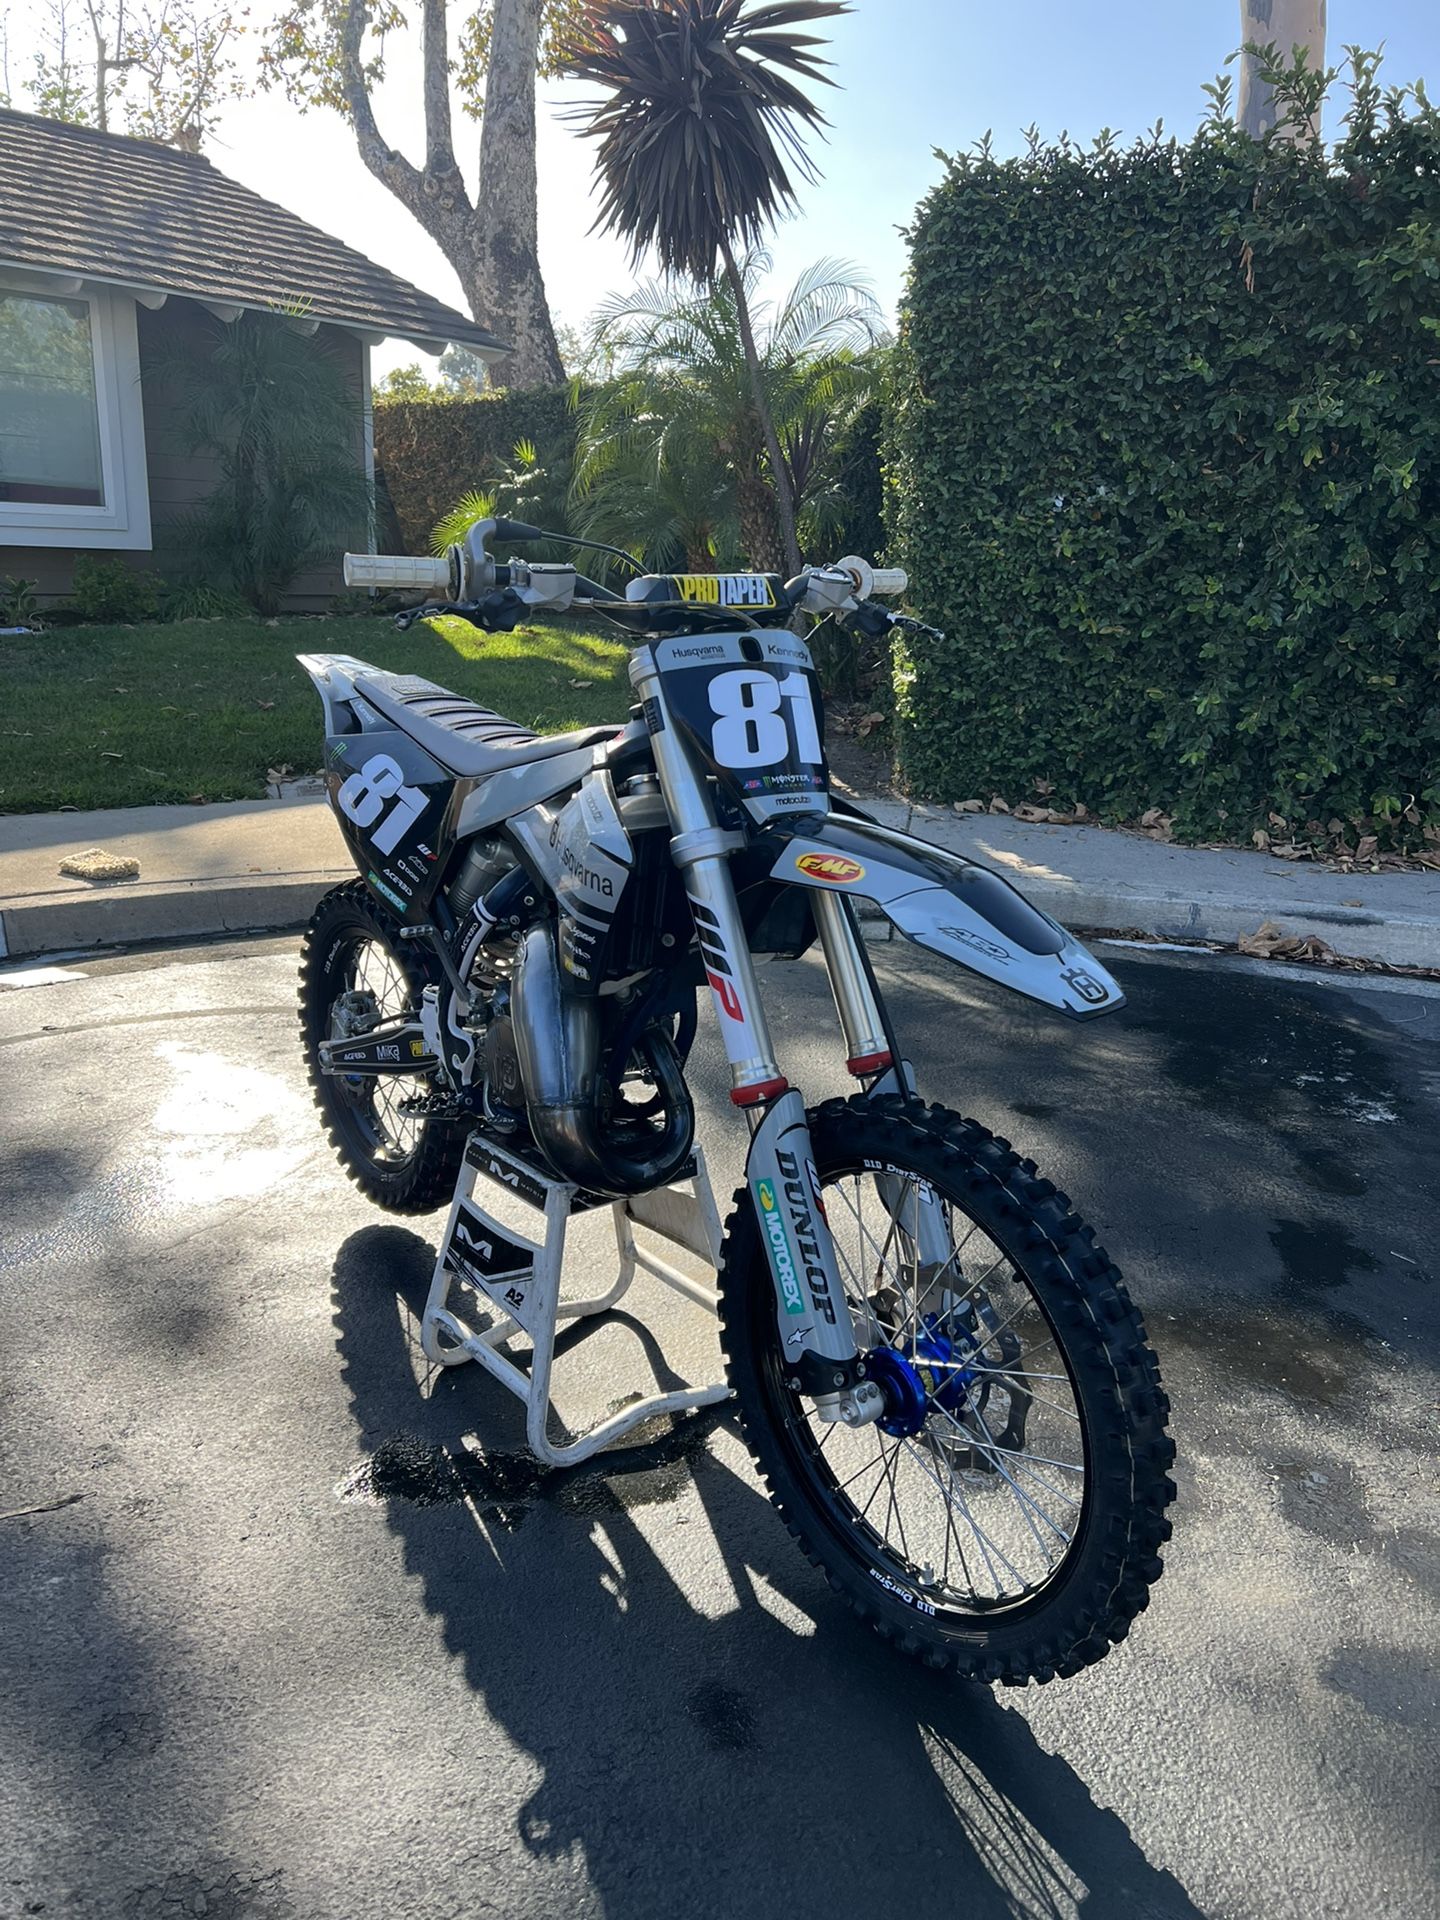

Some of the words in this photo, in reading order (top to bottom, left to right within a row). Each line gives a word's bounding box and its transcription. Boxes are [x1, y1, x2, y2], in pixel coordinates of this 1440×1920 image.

[672, 644, 724, 658] Husqvarna
[708, 669, 823, 769] 81
[338, 754, 430, 856] 81
[799, 857, 860, 876] FMF
[765, 1211, 801, 1309] MOTOREX
[775, 1148, 837, 1325] DUNLOP
[504, 1287, 525, 1307] A2
